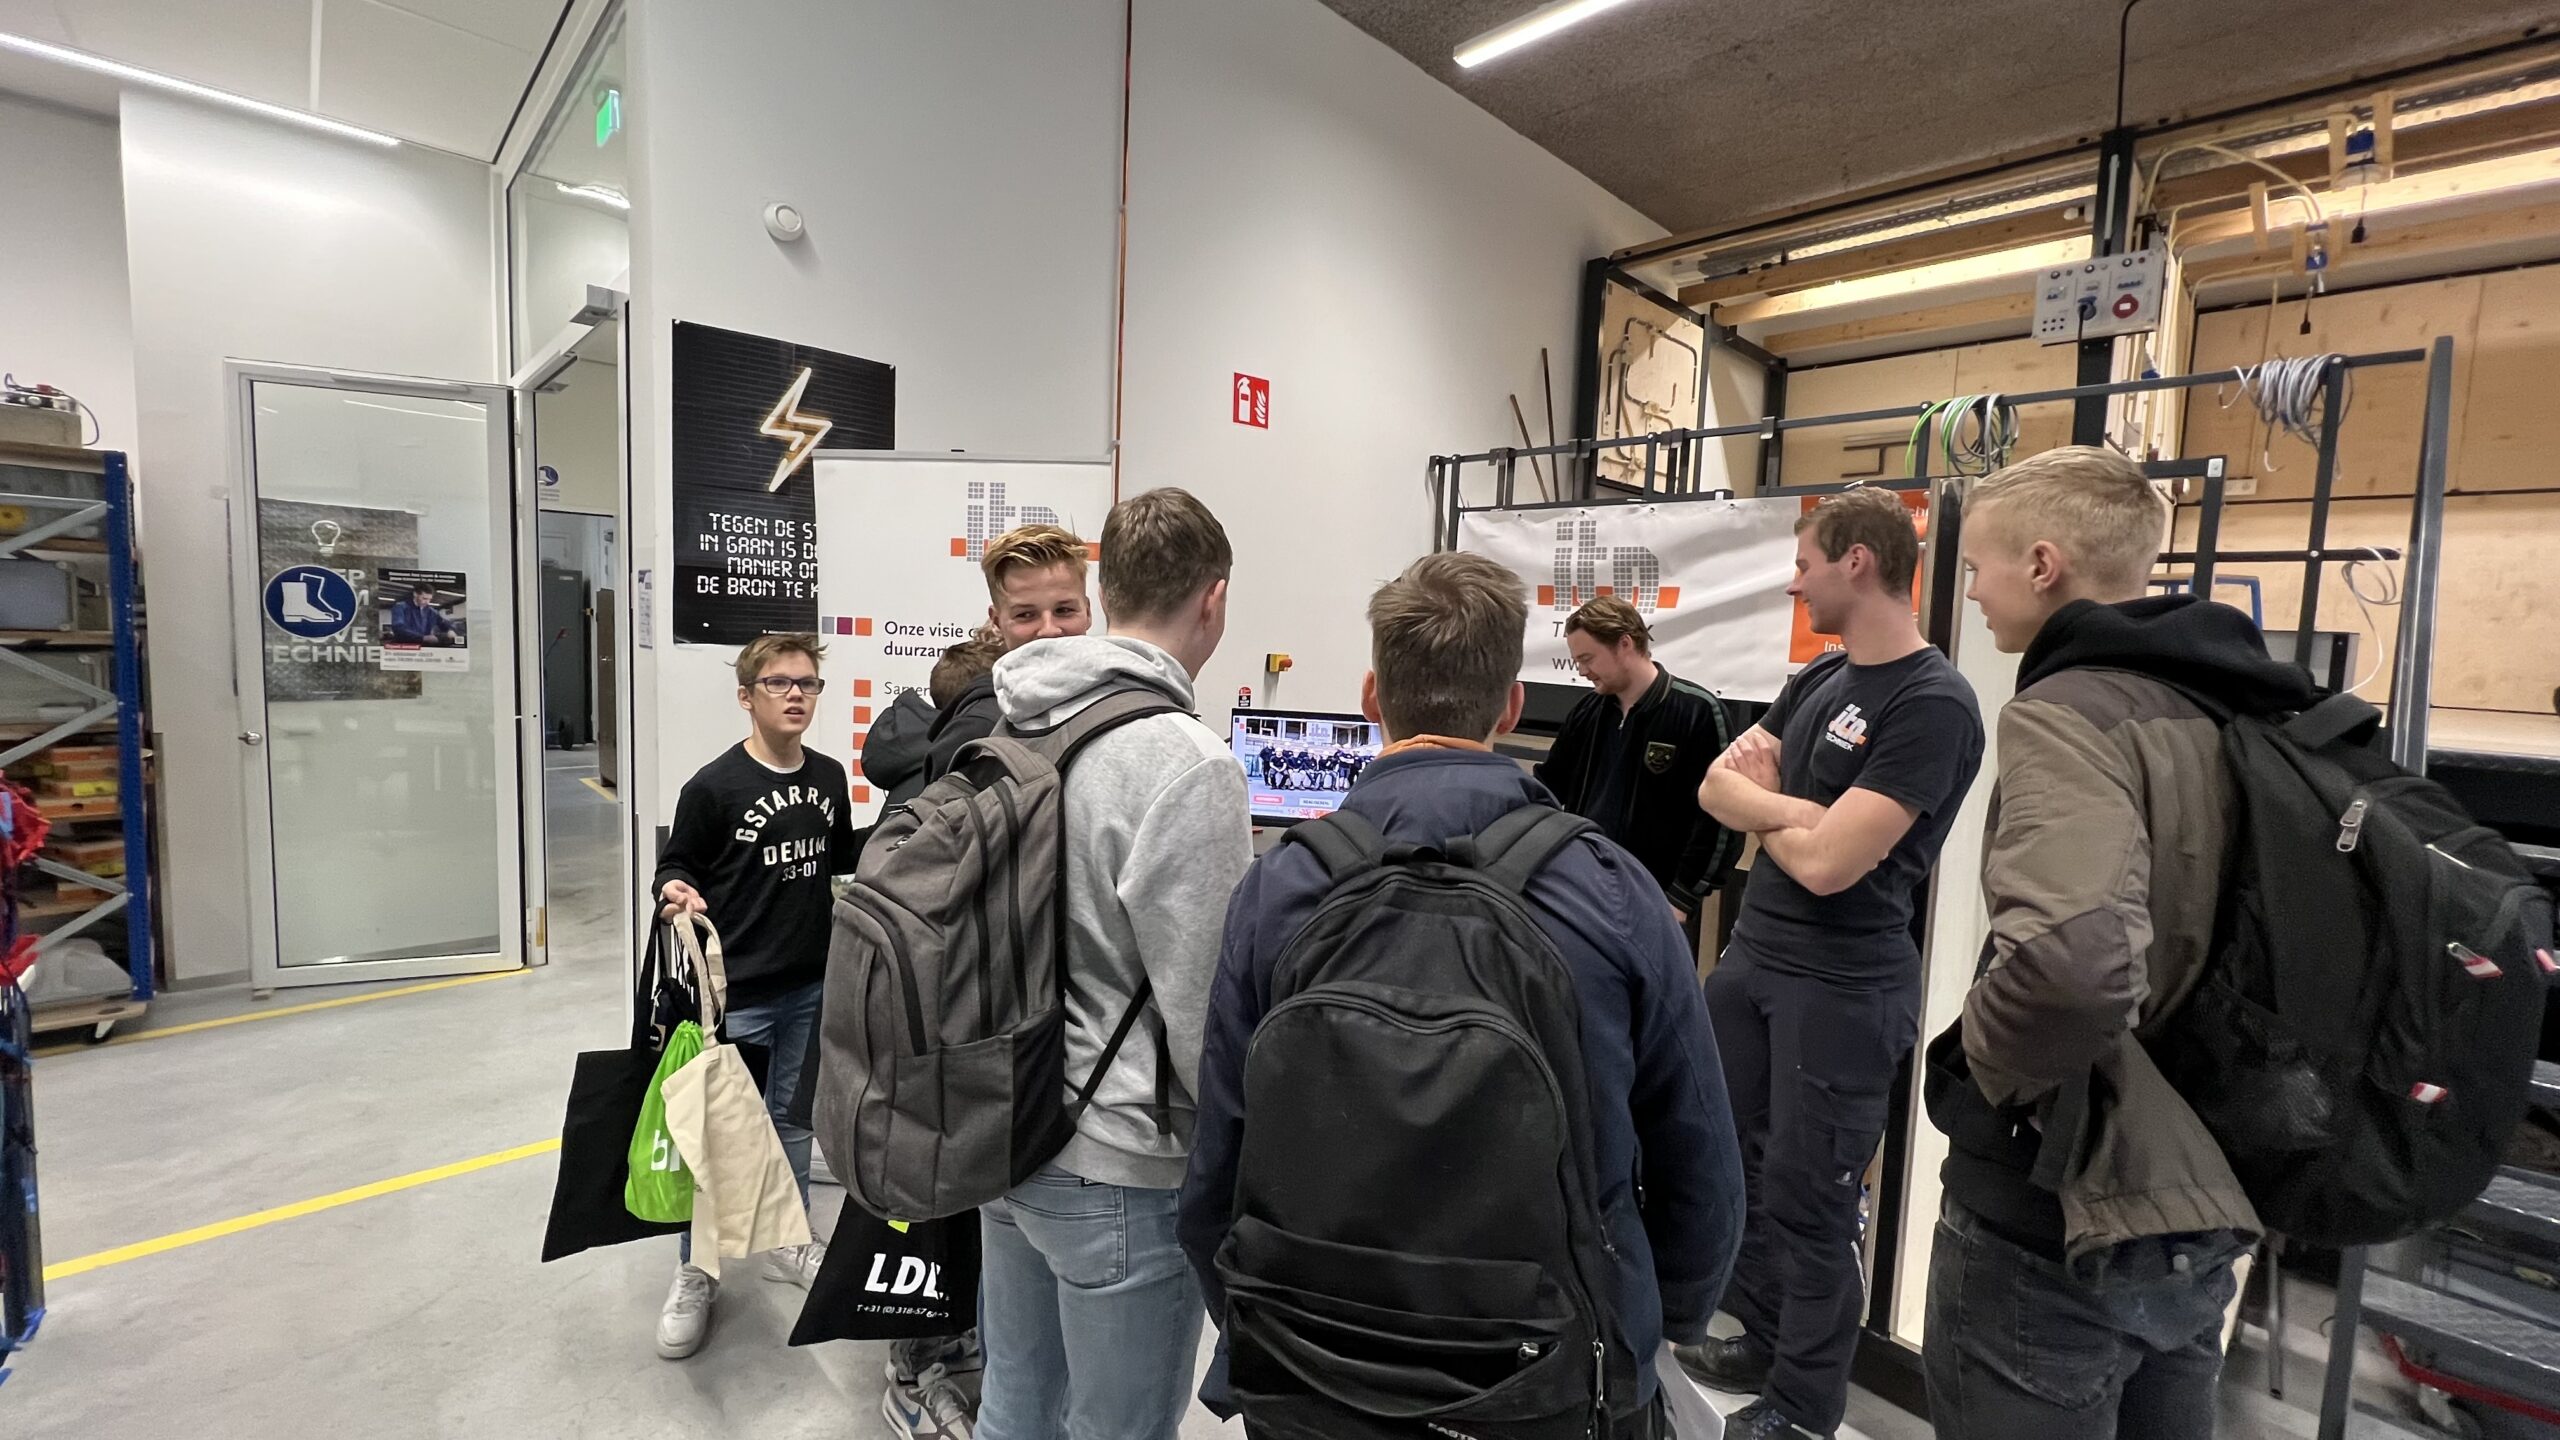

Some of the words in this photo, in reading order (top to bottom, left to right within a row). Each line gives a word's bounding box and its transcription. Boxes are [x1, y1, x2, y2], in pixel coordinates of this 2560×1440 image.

[709, 512, 768, 535] TEGEN
[775, 520, 796, 538] DE
[802, 522, 817, 540] S
[700, 533, 719, 552] IN
[726, 536, 775, 556] GAAN
[781, 540, 797, 558] IS
[727, 556, 793, 578] MANIER
[696, 575, 720, 594] DE
[727, 577, 776, 597] BRON
[783, 581, 804, 599] TE
[884, 621, 924, 637] Onze
[929, 624, 964, 640] visie
[763, 836, 826, 866] DENIM
